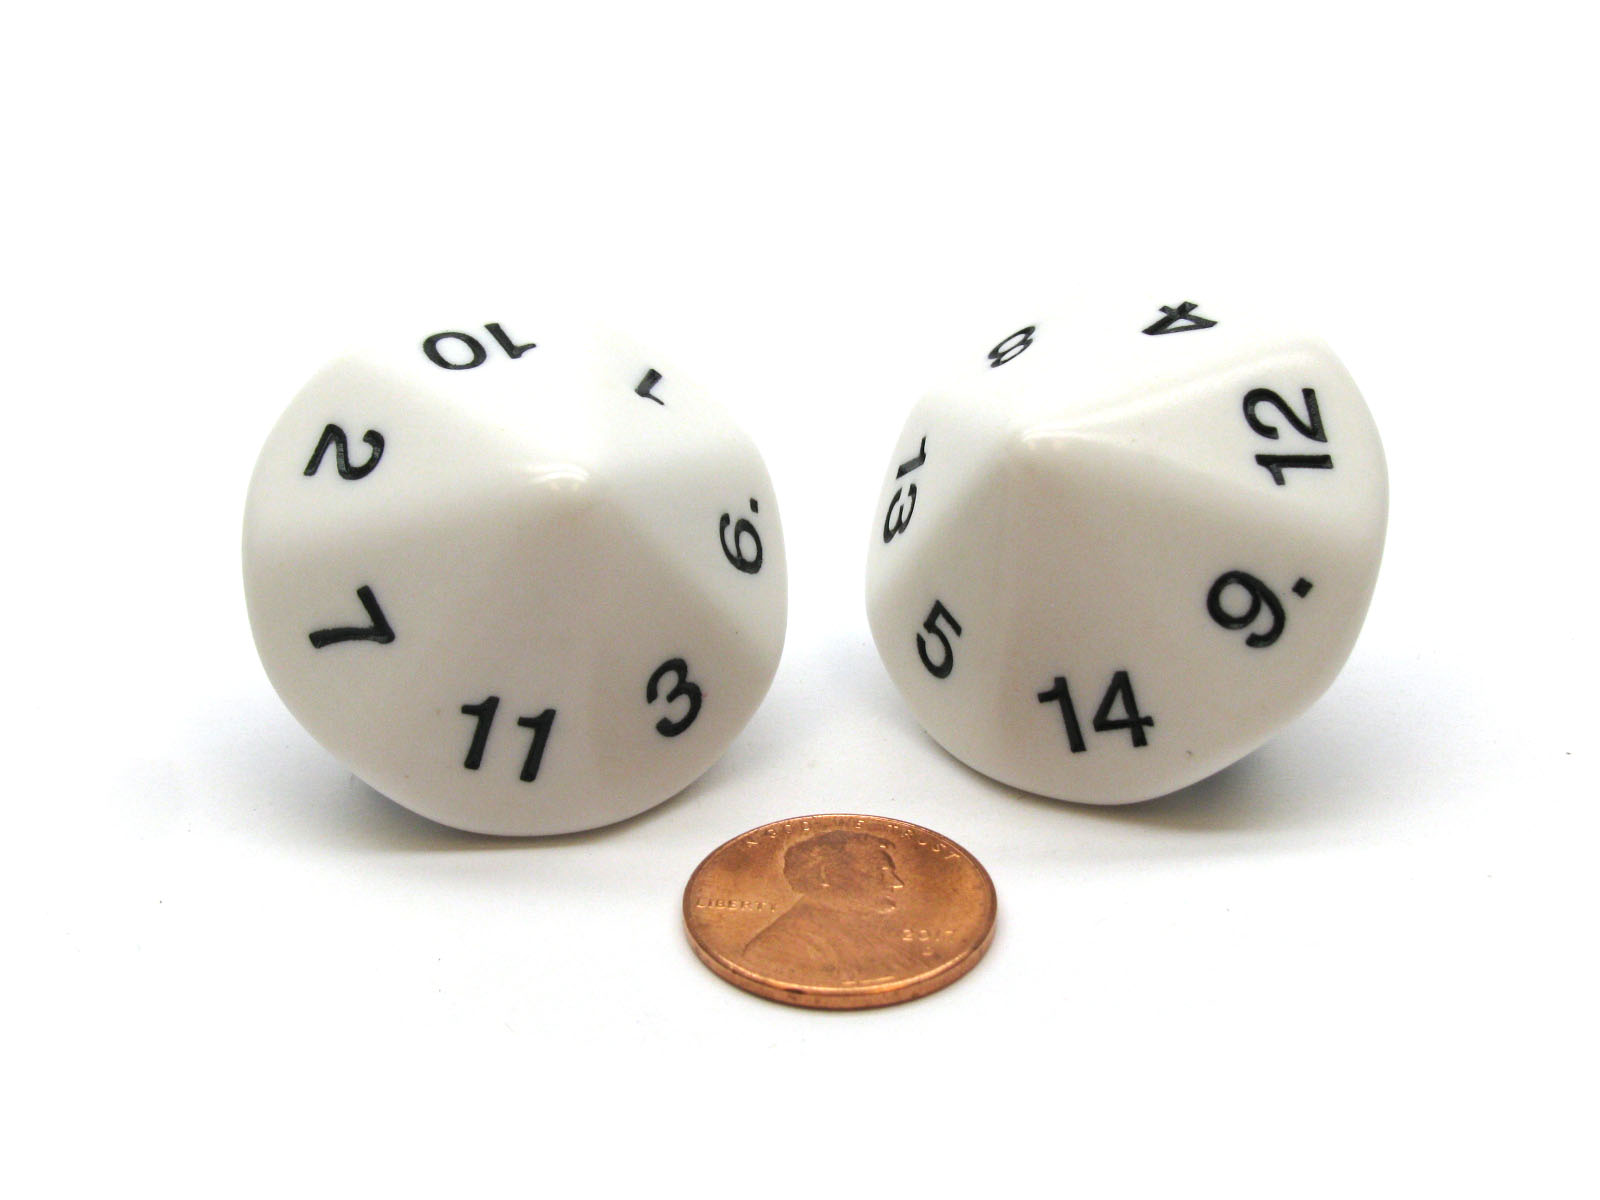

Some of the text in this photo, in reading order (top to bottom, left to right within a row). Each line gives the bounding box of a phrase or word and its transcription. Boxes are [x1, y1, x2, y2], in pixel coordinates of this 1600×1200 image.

[424, 323, 536, 370] 10
[988, 326, 1036, 368] 8
[1143, 301, 1218, 336] 4
[635, 368, 665, 406] 1
[304, 423, 385, 481] 2
[1242, 387, 1334, 485] 12
[883, 436, 927, 543] 13
[309, 585, 396, 650] 7
[915, 600, 963, 680] 5
[646, 658, 704, 739] 3
[1037, 670, 1155, 755] 14
[460, 695, 557, 783] 11
